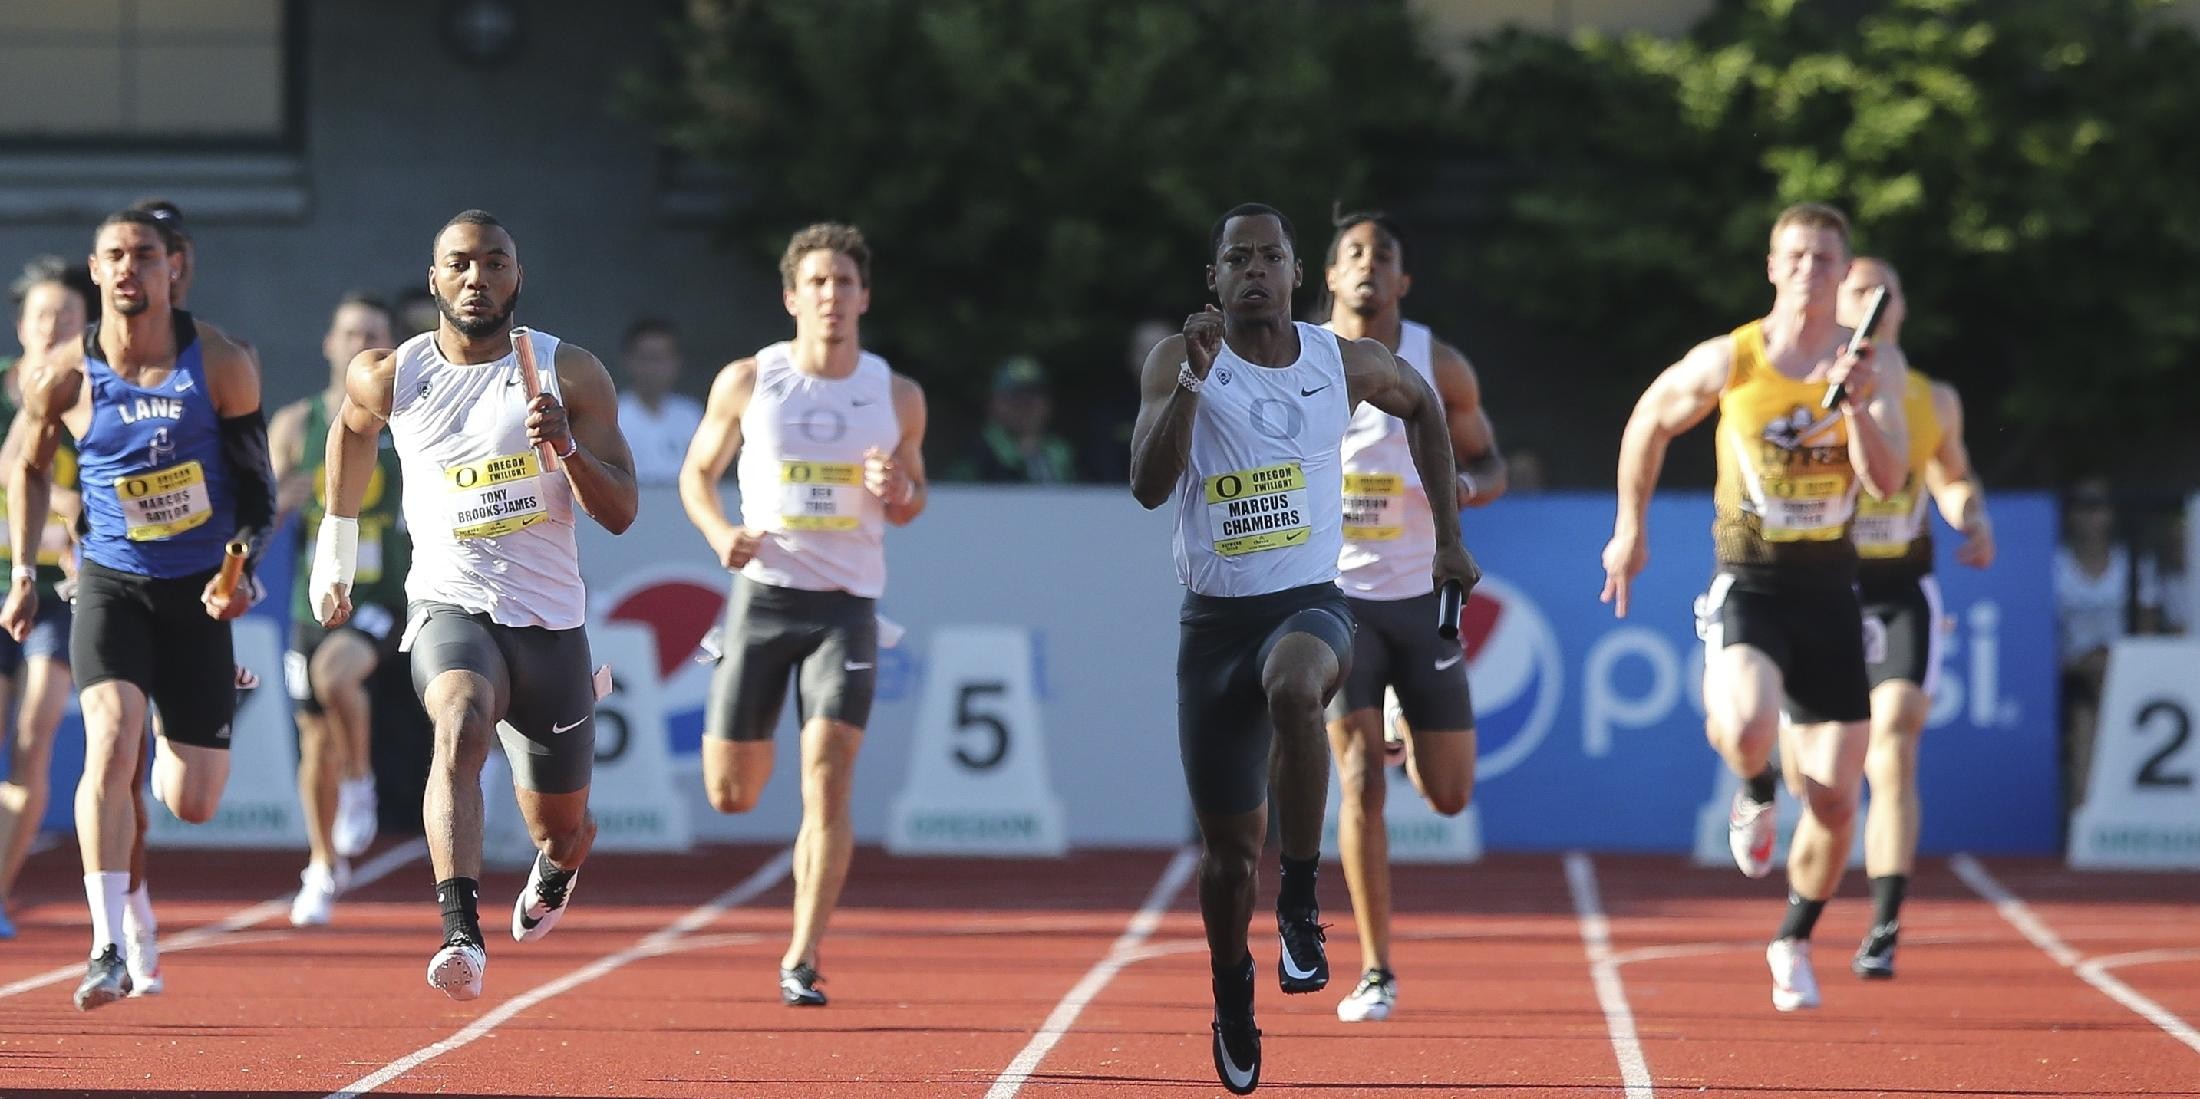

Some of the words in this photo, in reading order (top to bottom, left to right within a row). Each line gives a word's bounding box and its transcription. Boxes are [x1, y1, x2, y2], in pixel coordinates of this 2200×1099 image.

[117, 398, 184, 425] LANE
[487, 457, 526, 473] OREGON
[489, 468, 527, 481] TWILIGHT
[1252, 467, 1292, 483] OREGON
[480, 488, 508, 505] TONY
[1253, 478, 1293, 493] TWILIGHT
[138, 489, 190, 509] MARCUS
[458, 496, 537, 523] BROOKS-JAMES
[1228, 494, 1289, 518] MARCUS
[1222, 509, 1300, 536] CHAMBERS
[953, 681, 1009, 772] 5
[2135, 701, 2193, 786] 2
